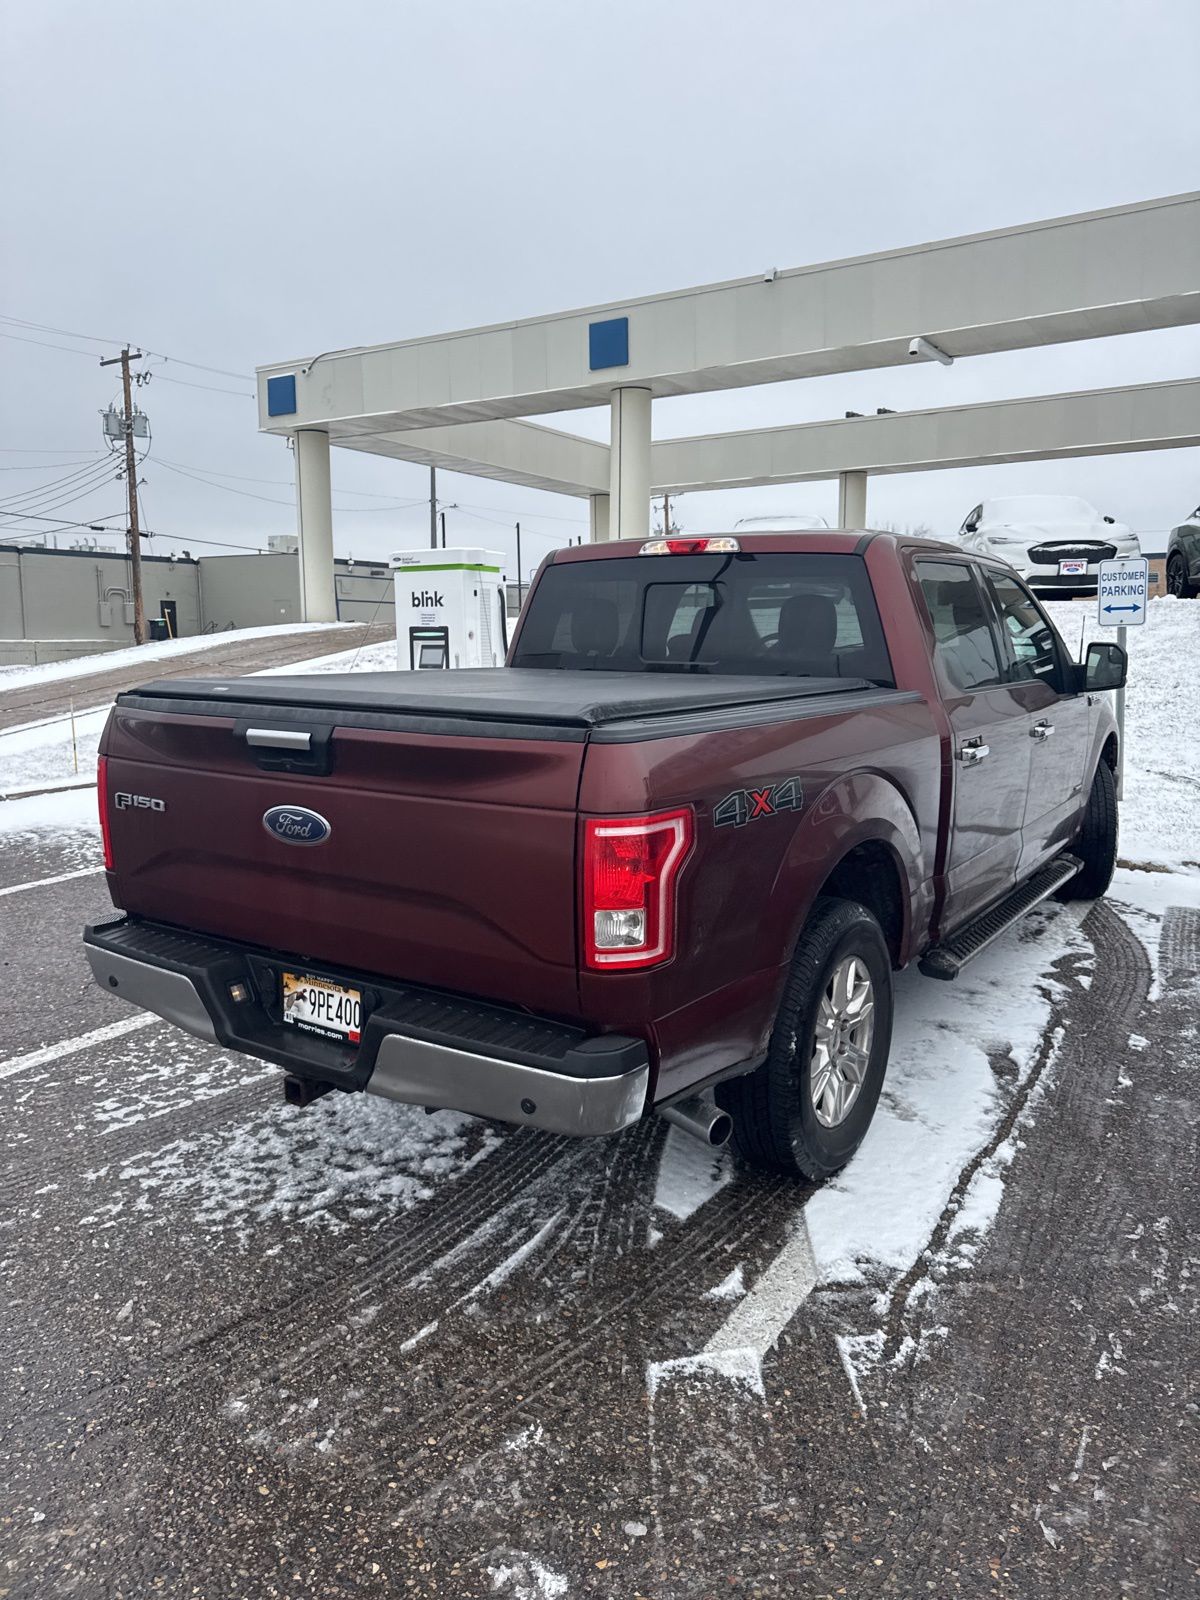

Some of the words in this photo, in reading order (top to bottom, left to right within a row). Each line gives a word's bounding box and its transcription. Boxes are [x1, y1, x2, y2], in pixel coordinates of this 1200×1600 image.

[1101, 571, 1145, 582] CUSTOMER
[411, 590, 444, 608] blink
[1101, 585, 1144, 597] PARKING
[275, 813, 312, 839] Ford
[309, 988, 361, 1029] 9PE400
[298, 1022, 343, 1040] morries.com
